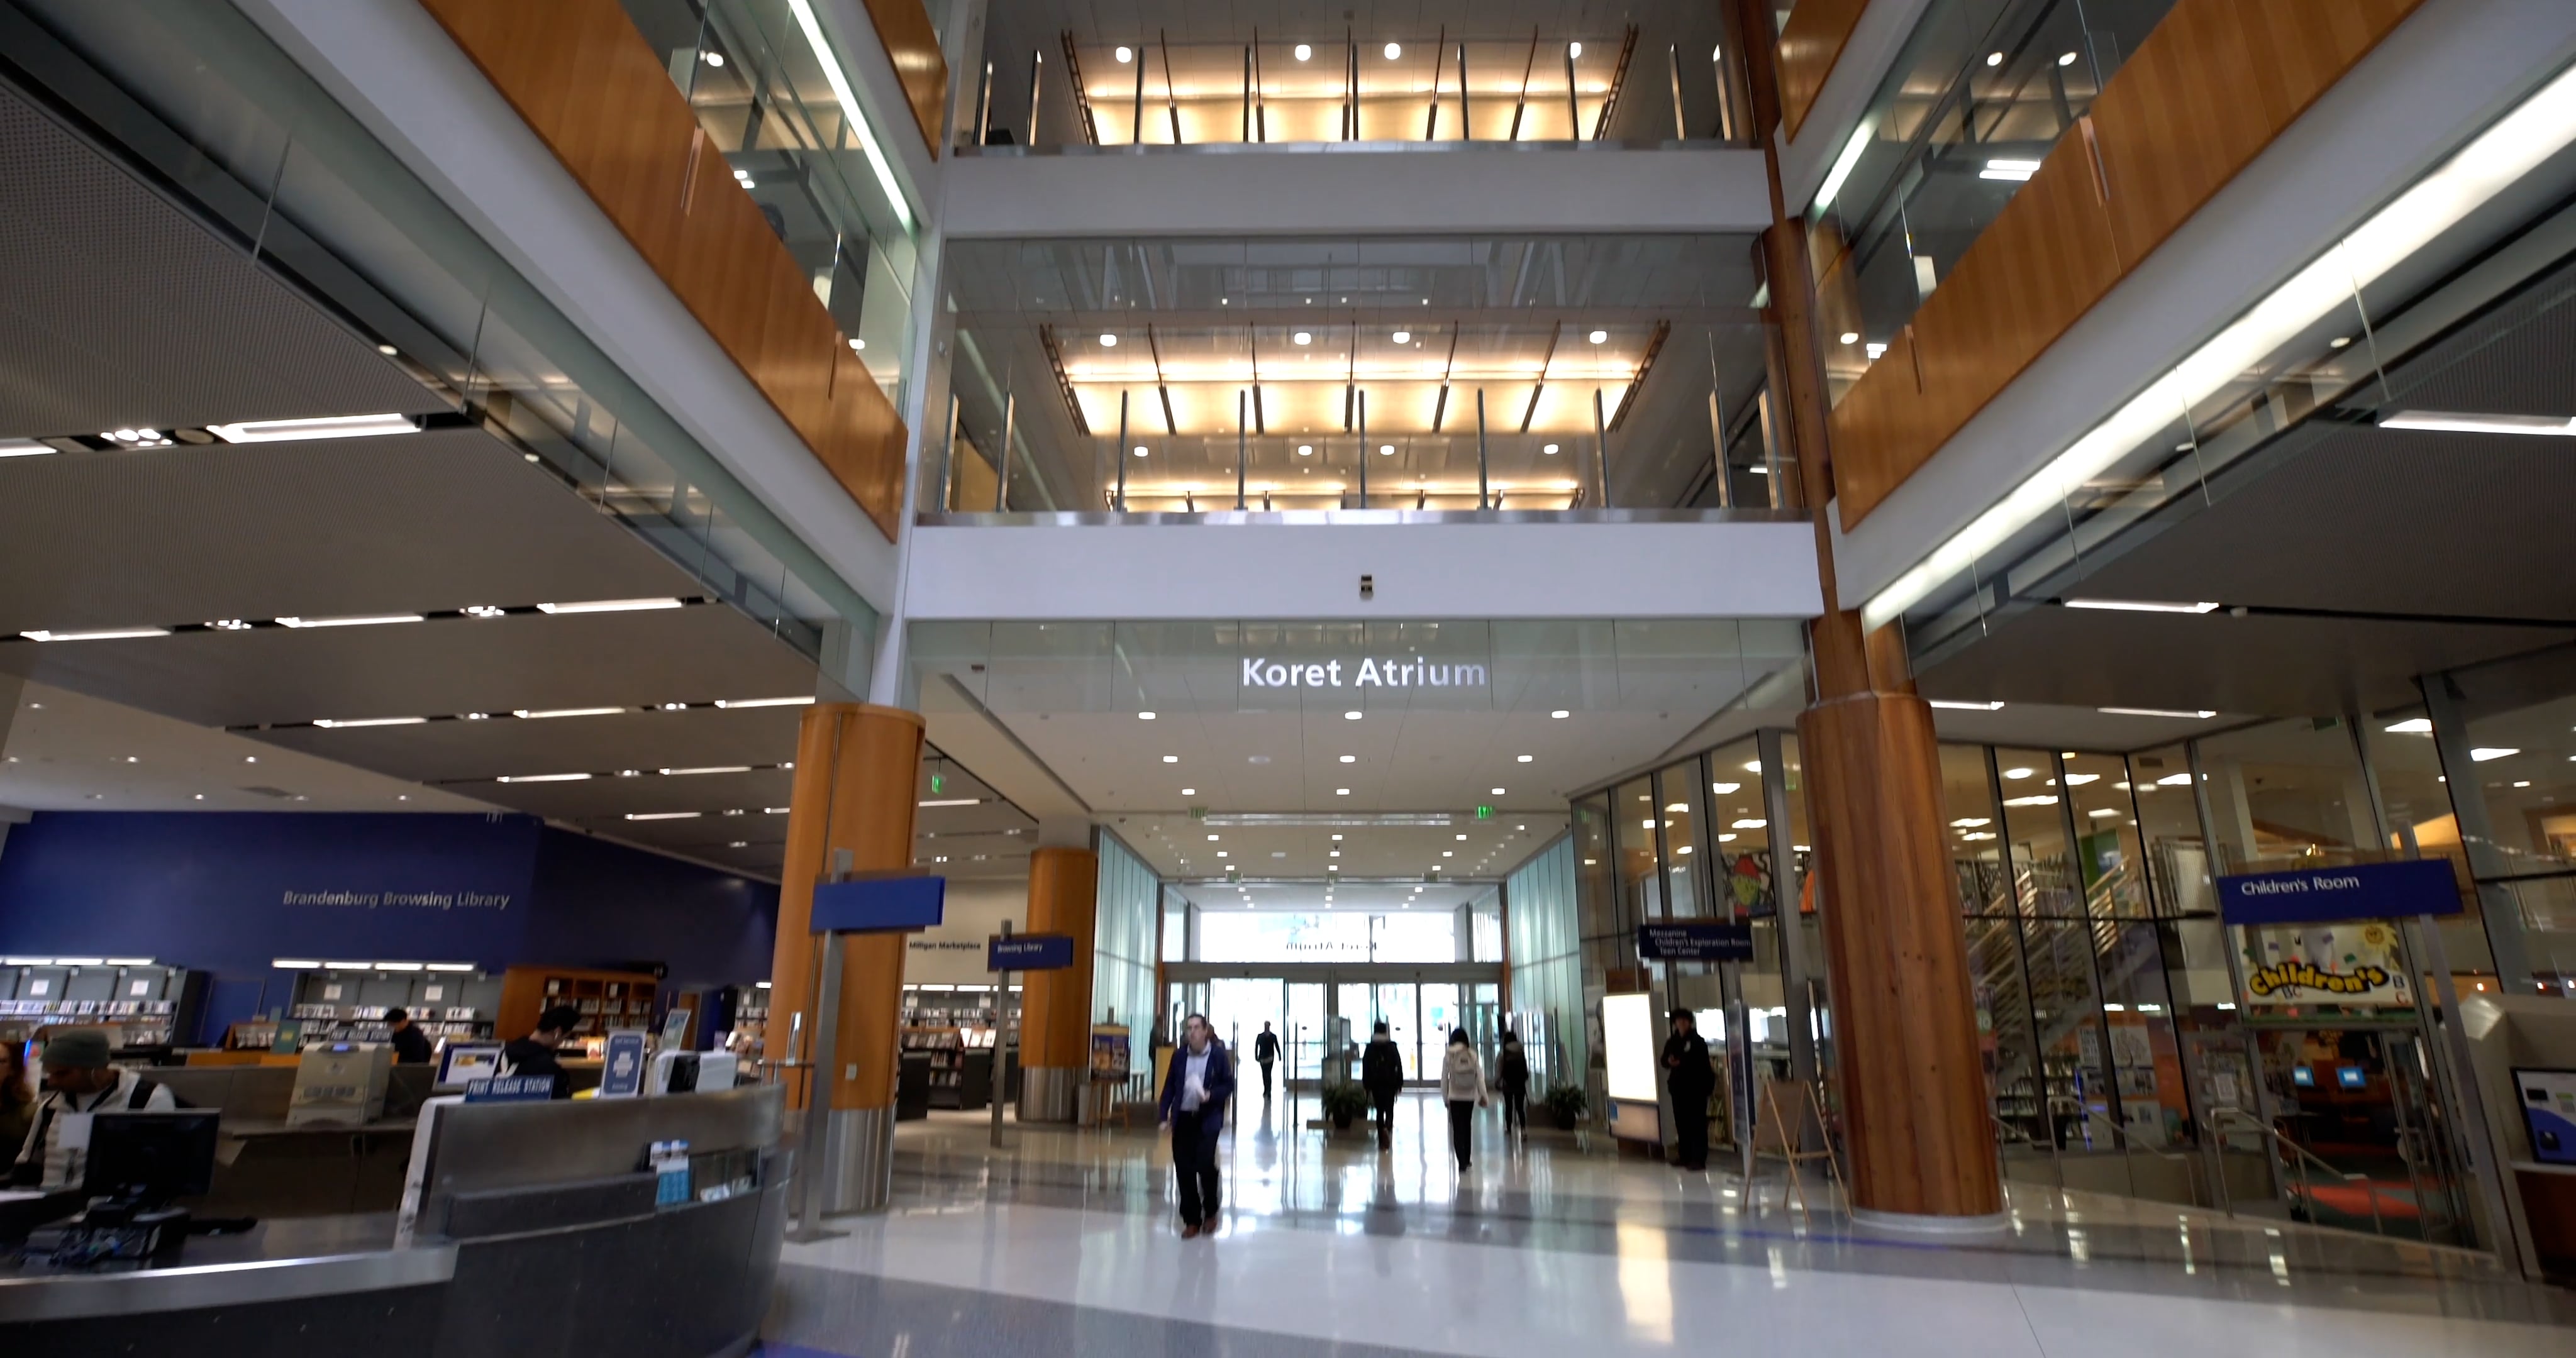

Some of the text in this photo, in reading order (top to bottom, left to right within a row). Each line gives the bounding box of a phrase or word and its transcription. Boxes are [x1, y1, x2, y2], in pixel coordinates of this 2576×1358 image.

[1242, 656, 1485, 687] Koret Atrium
[2241, 876, 2360, 896] Children's Room
[283, 890, 510, 910] Brandenburg Browsing Library
[1649, 929, 1687, 938] Mezzanine
[909, 941, 981, 952] Milligan Marketplace
[1023, 942, 1043, 954] Library
[1689, 937, 1729, 948] Exploration
[1730, 938, 1752, 947] Room
[1659, 947, 1701, 956] Teen Center
[468, 1077, 552, 1095] PRINT RELEASE STATION
